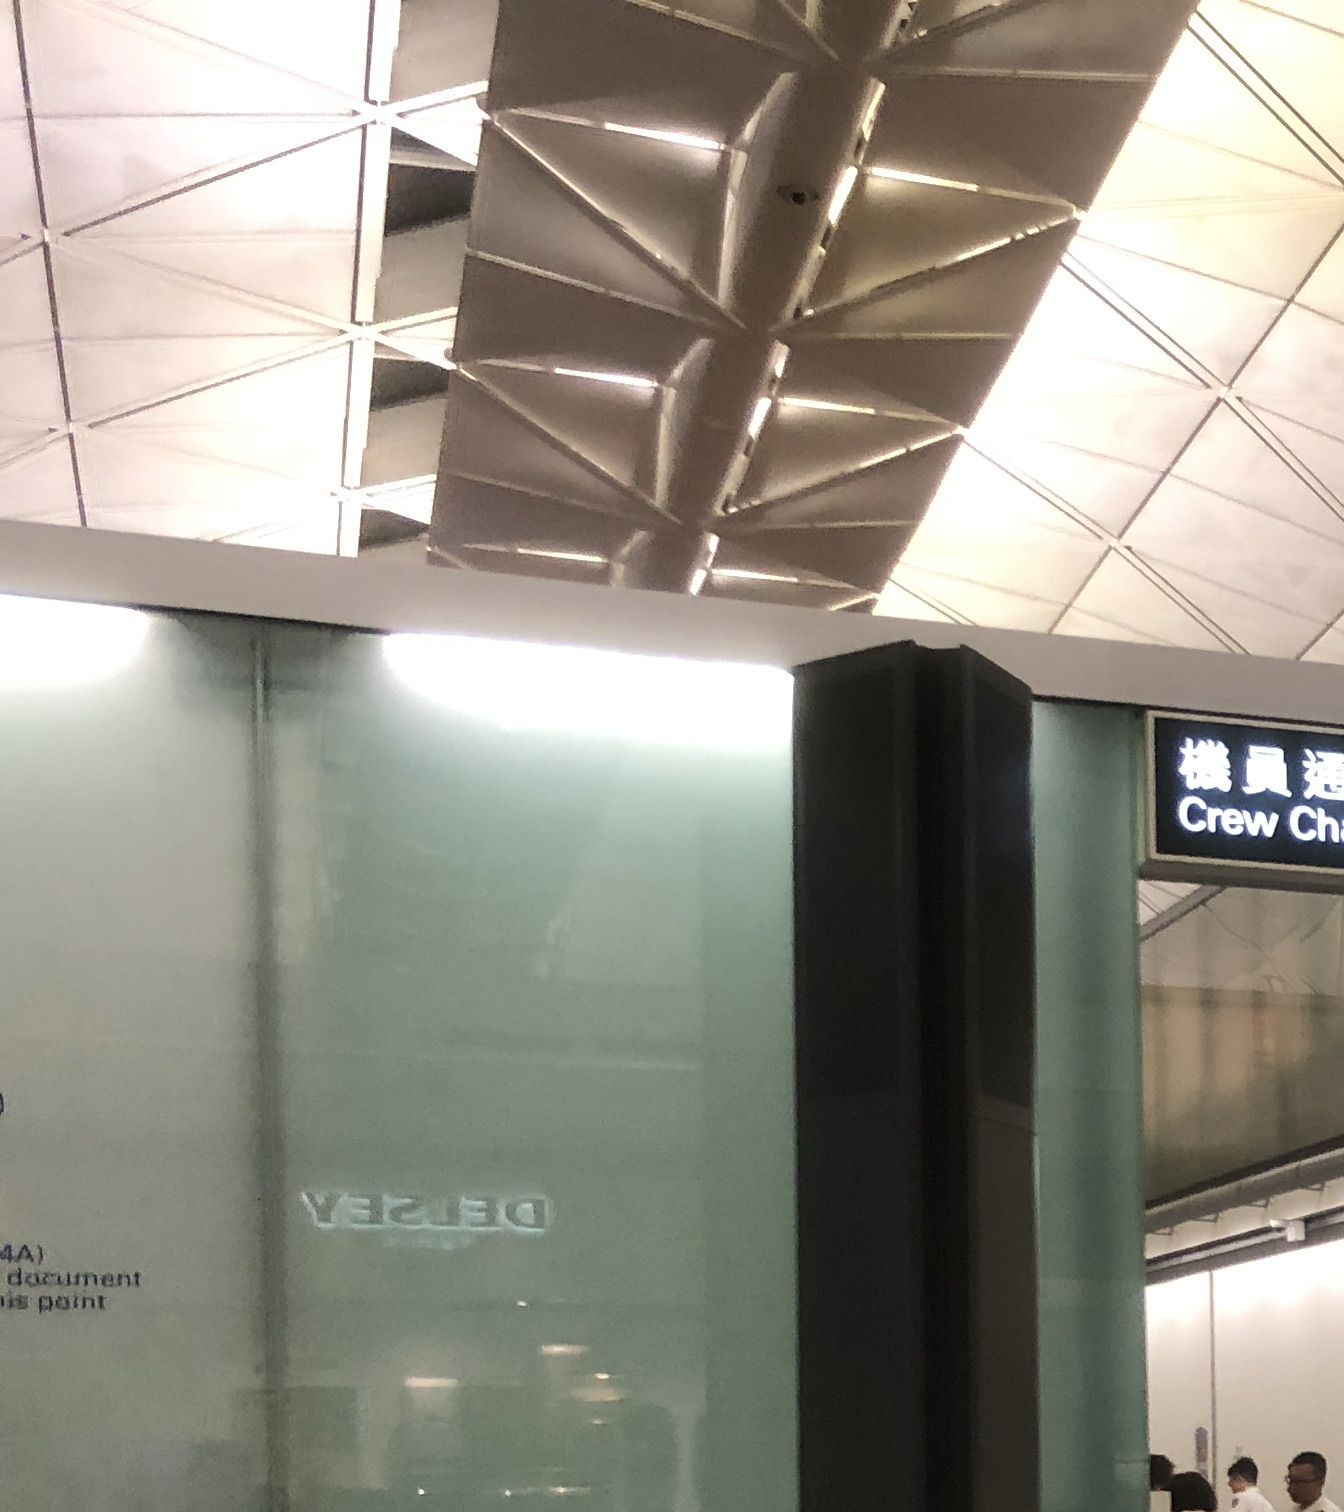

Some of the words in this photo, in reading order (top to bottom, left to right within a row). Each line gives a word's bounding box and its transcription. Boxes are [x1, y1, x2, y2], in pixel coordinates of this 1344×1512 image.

[1177, 796, 1279, 838] Crew
[7, 1267, 142, 1288] document
[38, 1293, 107, 1313] point
